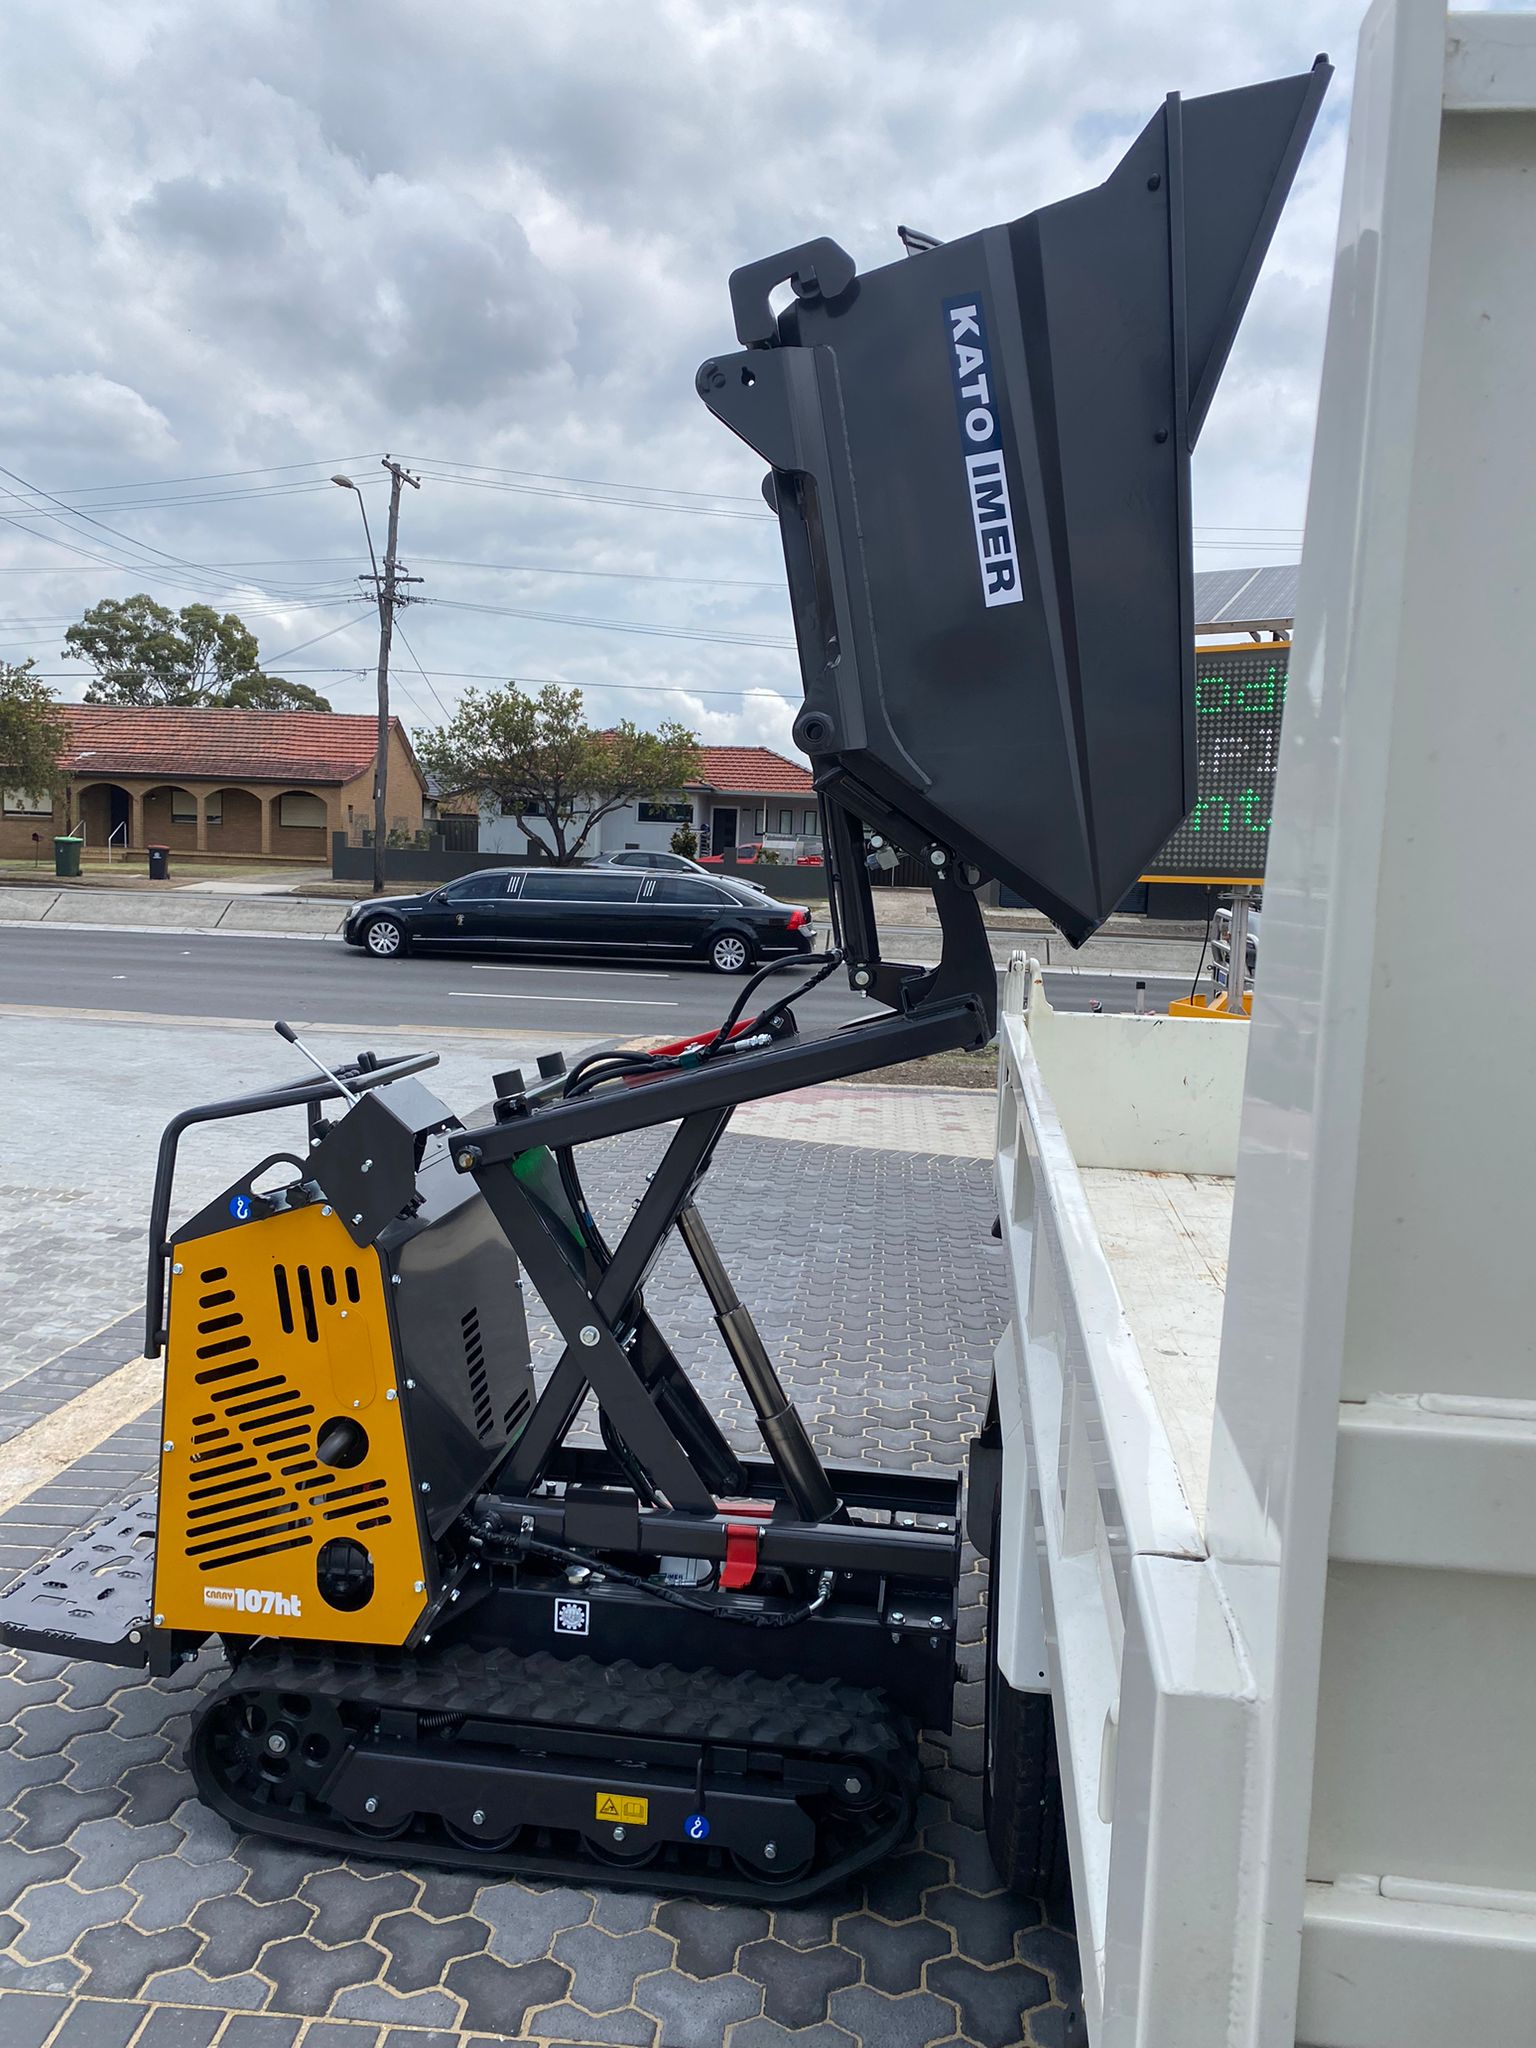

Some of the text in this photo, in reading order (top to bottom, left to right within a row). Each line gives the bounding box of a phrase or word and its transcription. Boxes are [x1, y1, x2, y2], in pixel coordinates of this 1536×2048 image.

[949, 304, 1016, 595] KATO IMER
[234, 1587, 302, 1617] 107ht
